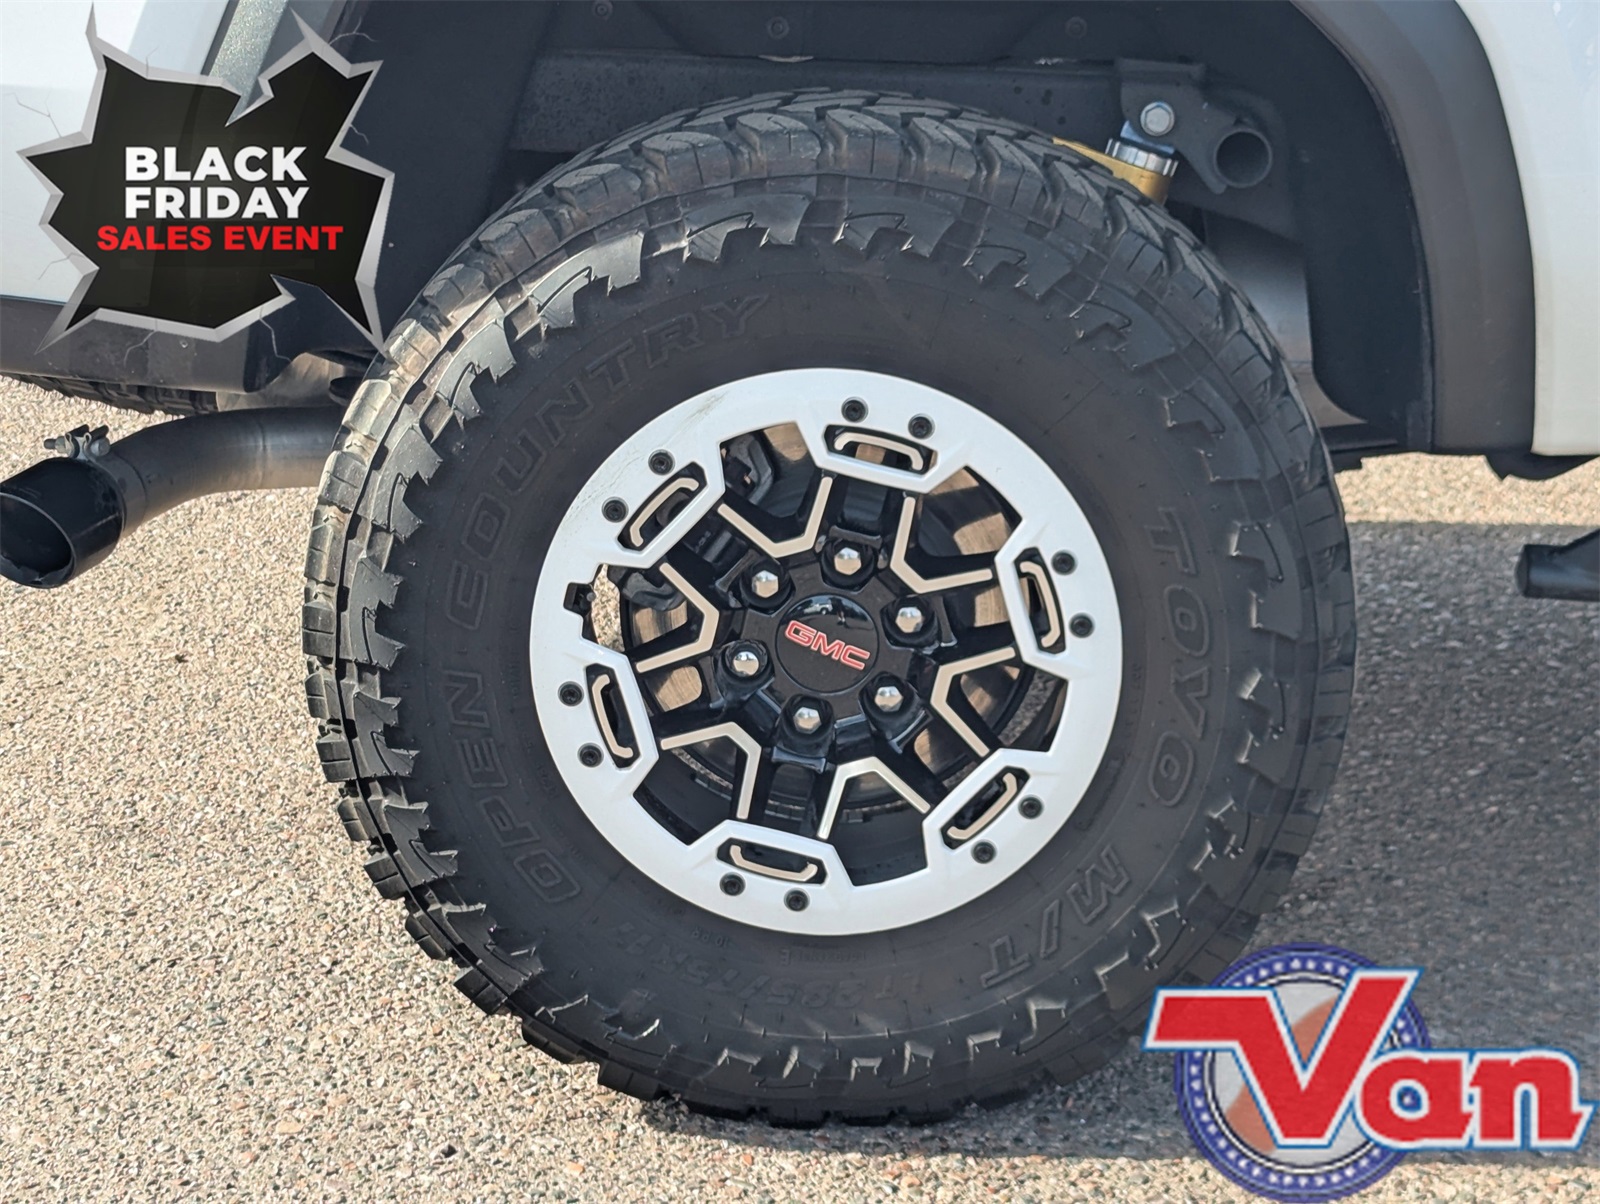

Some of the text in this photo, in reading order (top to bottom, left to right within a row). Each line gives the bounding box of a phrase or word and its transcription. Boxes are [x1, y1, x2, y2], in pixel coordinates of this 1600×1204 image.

[440, 292, 771, 904] OPEN COUNTRY
[784, 619, 871, 671] GMC
[979, 506, 1211, 990] TOYO M/T
